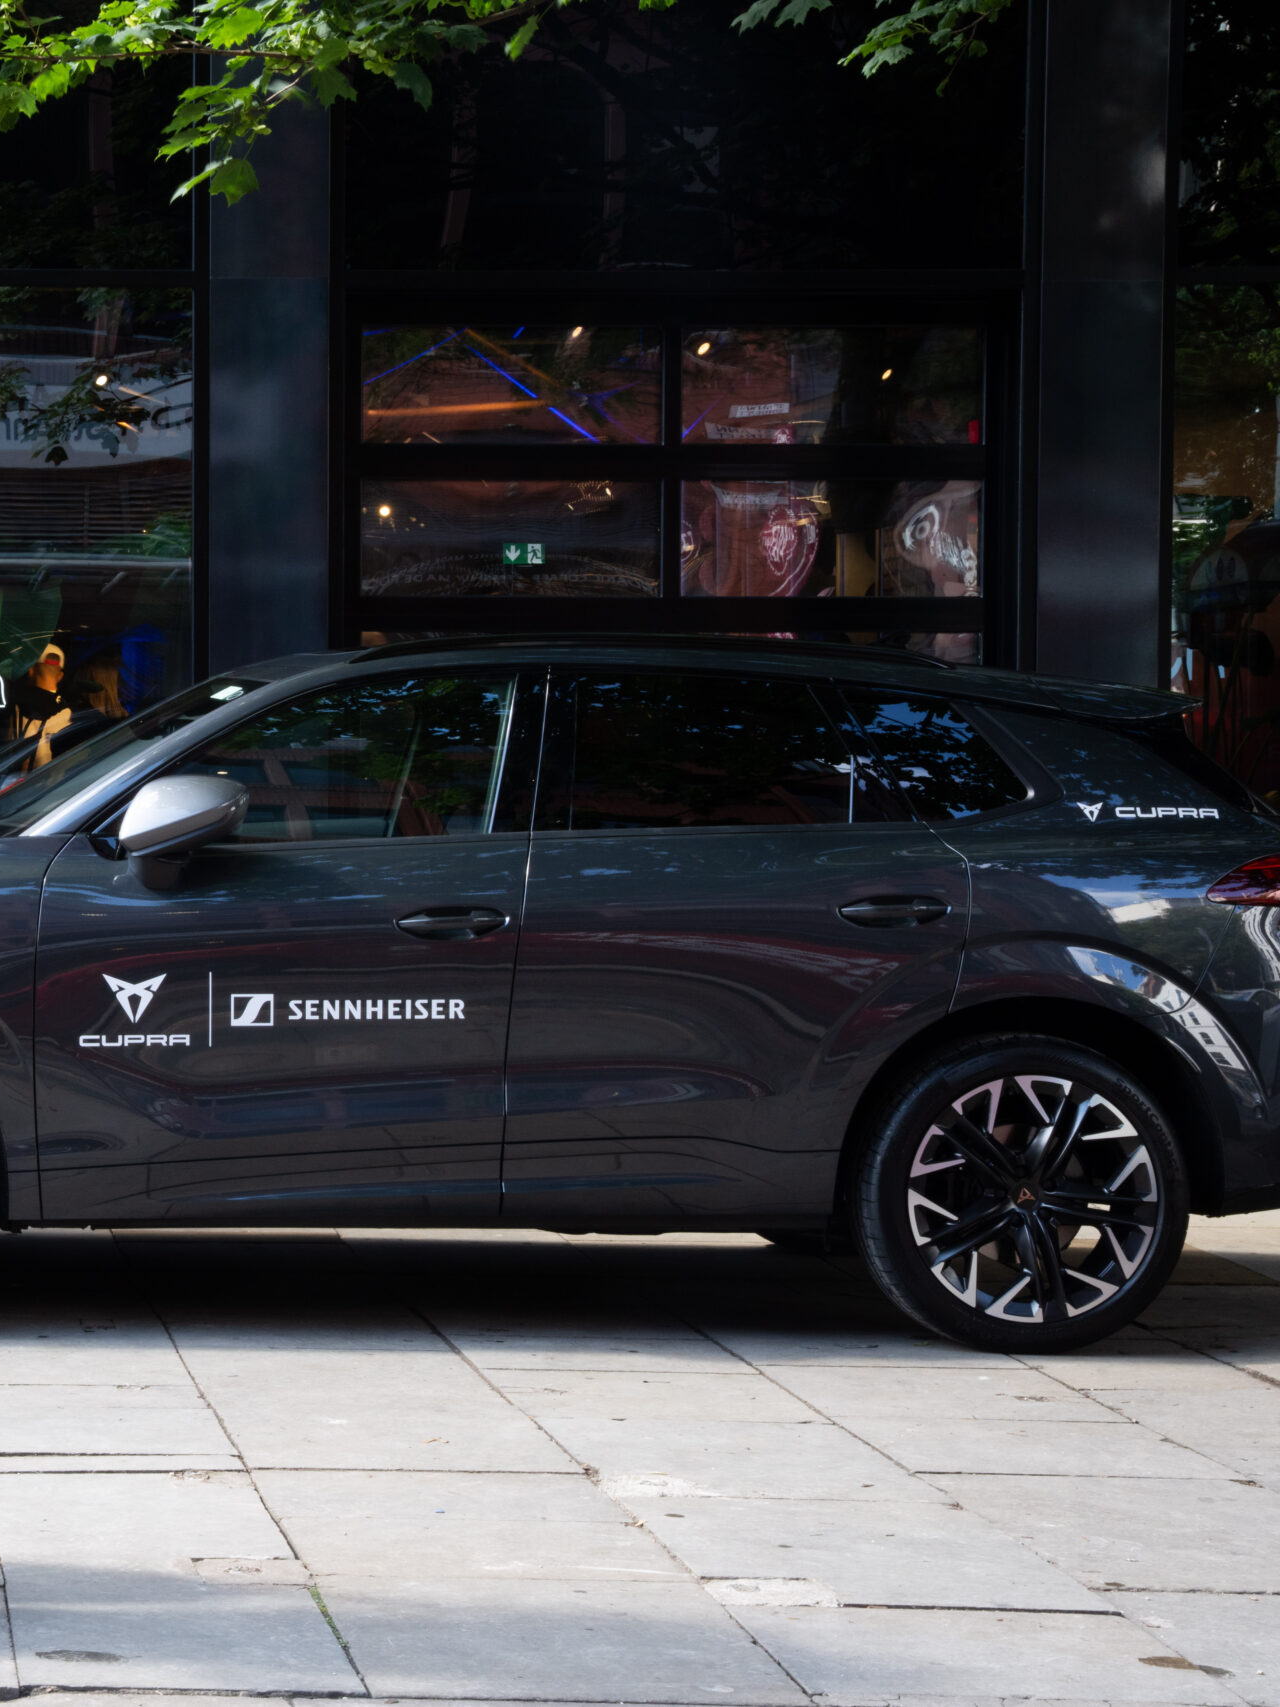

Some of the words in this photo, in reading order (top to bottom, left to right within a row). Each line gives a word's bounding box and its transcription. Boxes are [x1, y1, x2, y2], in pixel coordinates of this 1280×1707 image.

[1115, 807, 1220, 819] CUPRA
[288, 998, 466, 1020] SENNHEISER
[78, 1034, 190, 1048] CUPRA
